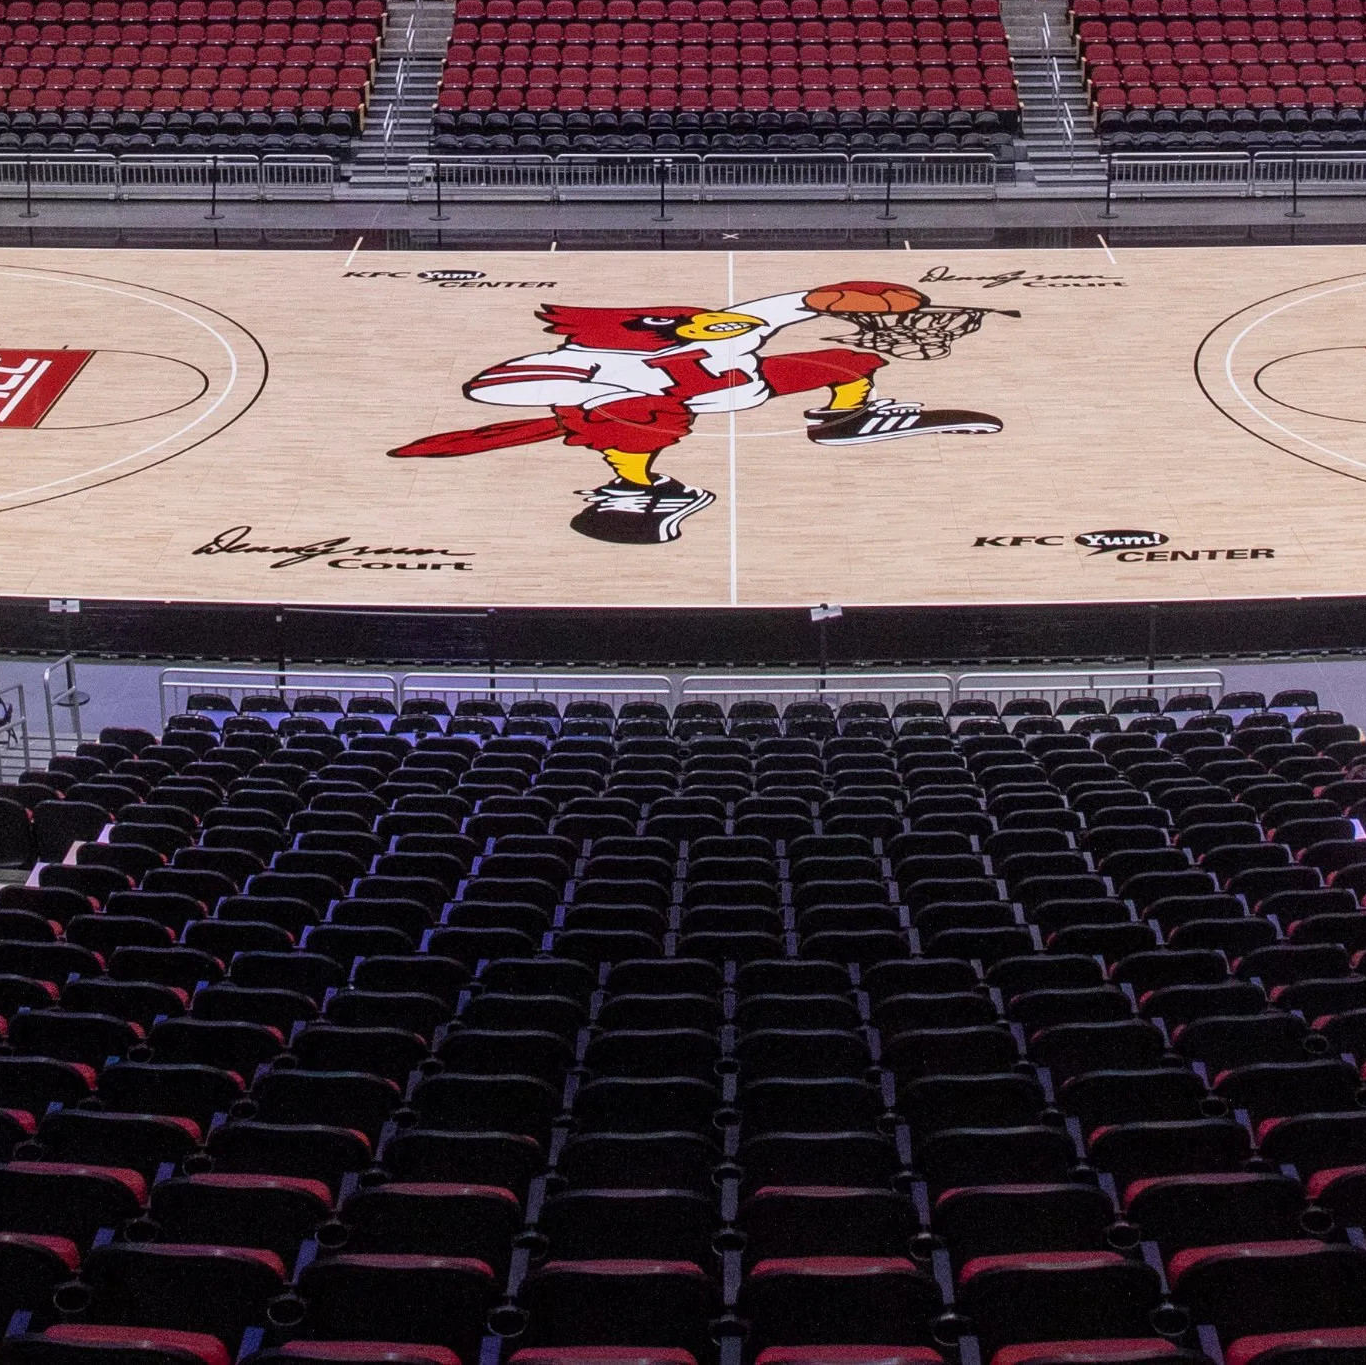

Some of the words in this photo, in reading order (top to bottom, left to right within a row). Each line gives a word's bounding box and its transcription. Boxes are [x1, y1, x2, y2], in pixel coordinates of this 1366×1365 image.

[425, 271, 482, 279] Yum!
[971, 536, 1065, 547] KFC
[1081, 534, 1162, 546] Yum!
[1117, 548, 1275, 563] CENTER
[328, 559, 473, 571] Court
